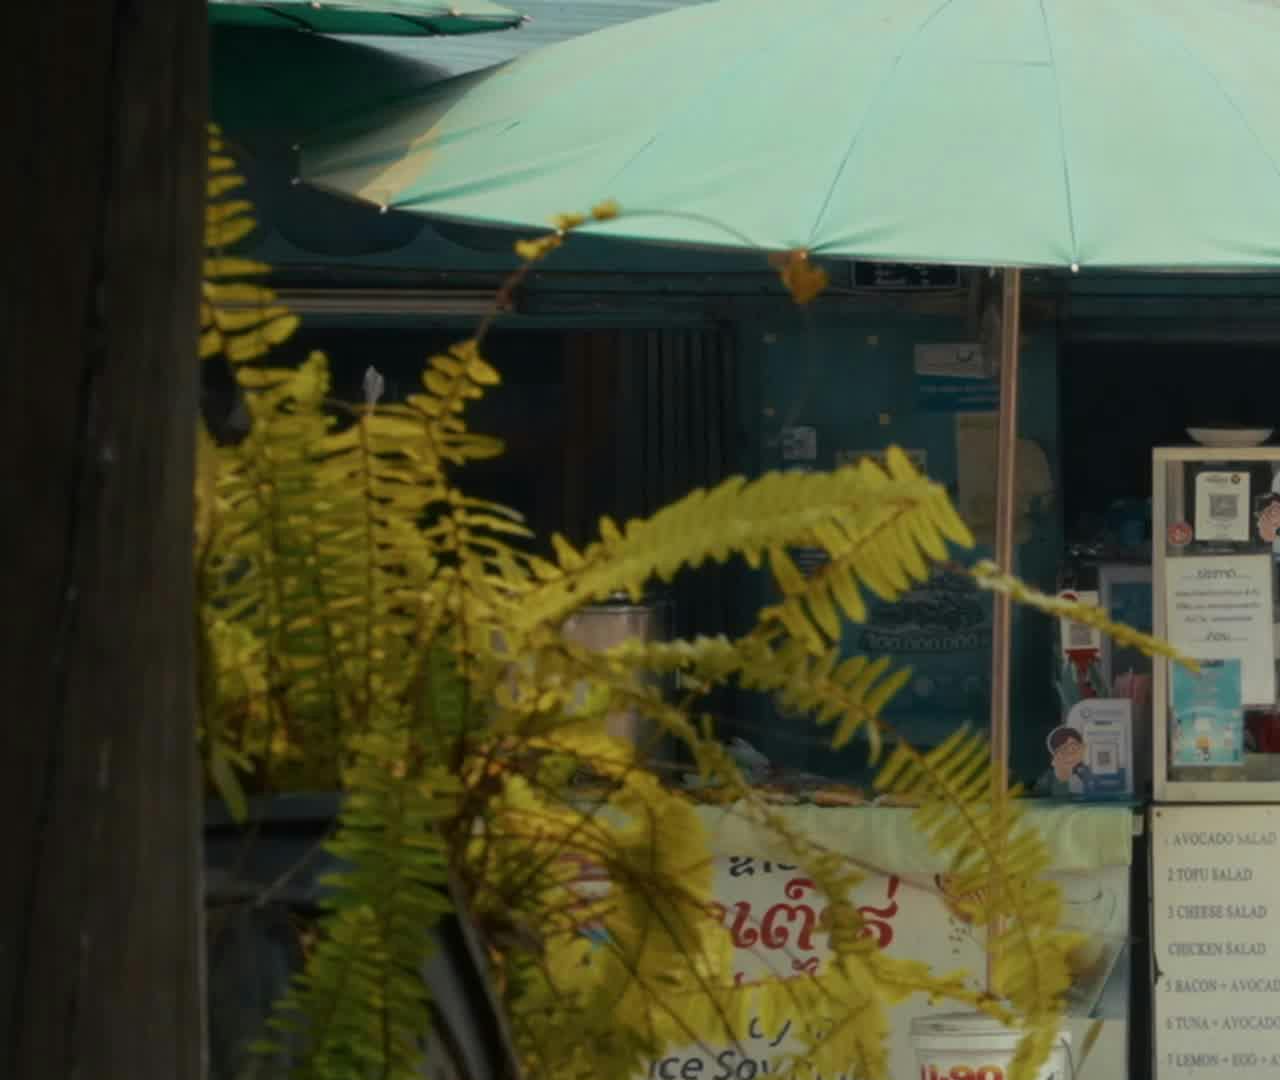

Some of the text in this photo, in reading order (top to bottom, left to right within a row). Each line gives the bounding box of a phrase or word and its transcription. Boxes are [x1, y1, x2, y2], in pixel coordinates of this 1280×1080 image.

[1174, 832, 1277, 846] AVOCADO SALAD
[1176, 867, 1208, 881] TOFU
[1212, 867, 1253, 881] SALAD
[1176, 905, 1224, 919] CHEESE
[1226, 905, 1267, 919] SALAD
[1168, 942, 1266, 956] CHICKEN SALAD
[1175, 979, 1217, 993] BACON
[1175, 1016, 1209, 1030] TUNA
[1176, 1053, 1218, 1067] LEMON
